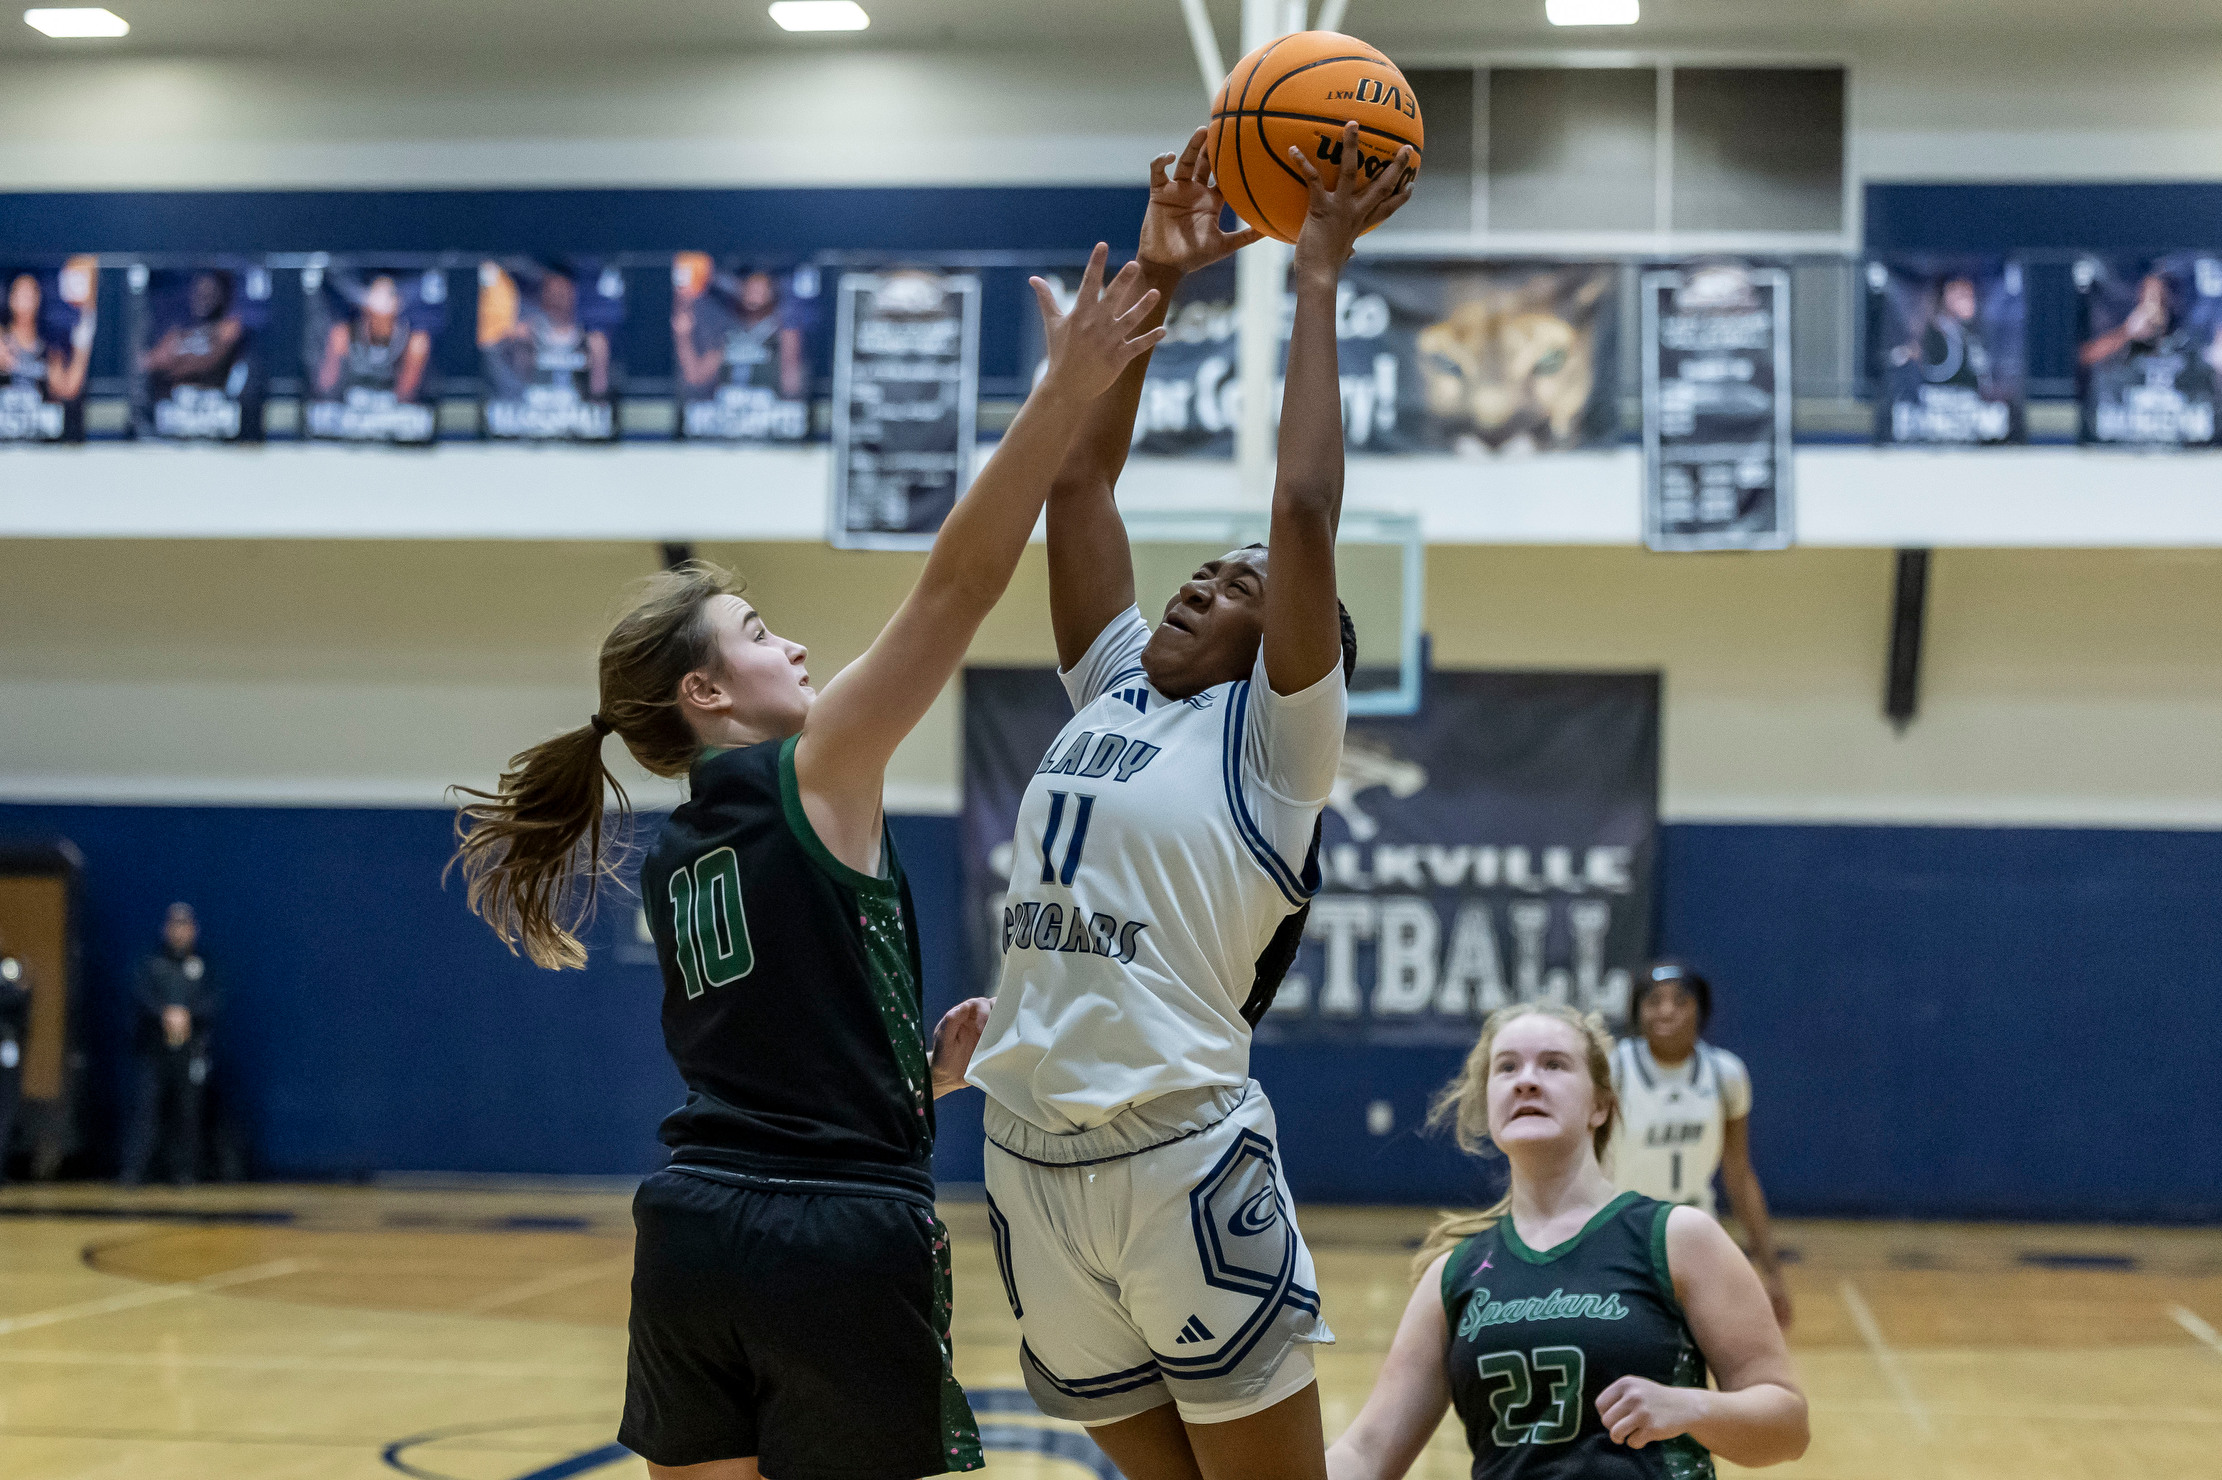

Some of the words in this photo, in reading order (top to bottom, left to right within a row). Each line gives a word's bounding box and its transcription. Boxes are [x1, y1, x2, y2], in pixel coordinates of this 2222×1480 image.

[1324, 90, 1354, 101] NXT
[1356, 78, 1416, 120] EVO
[1036, 731, 1162, 782] LADY
[1040, 789, 1097, 888] 11
[668, 846, 755, 1000] 10
[1003, 902, 1149, 964] COUGARS
[1458, 1287, 1630, 1342] Spartans
[1477, 1345, 1585, 1447] 23
